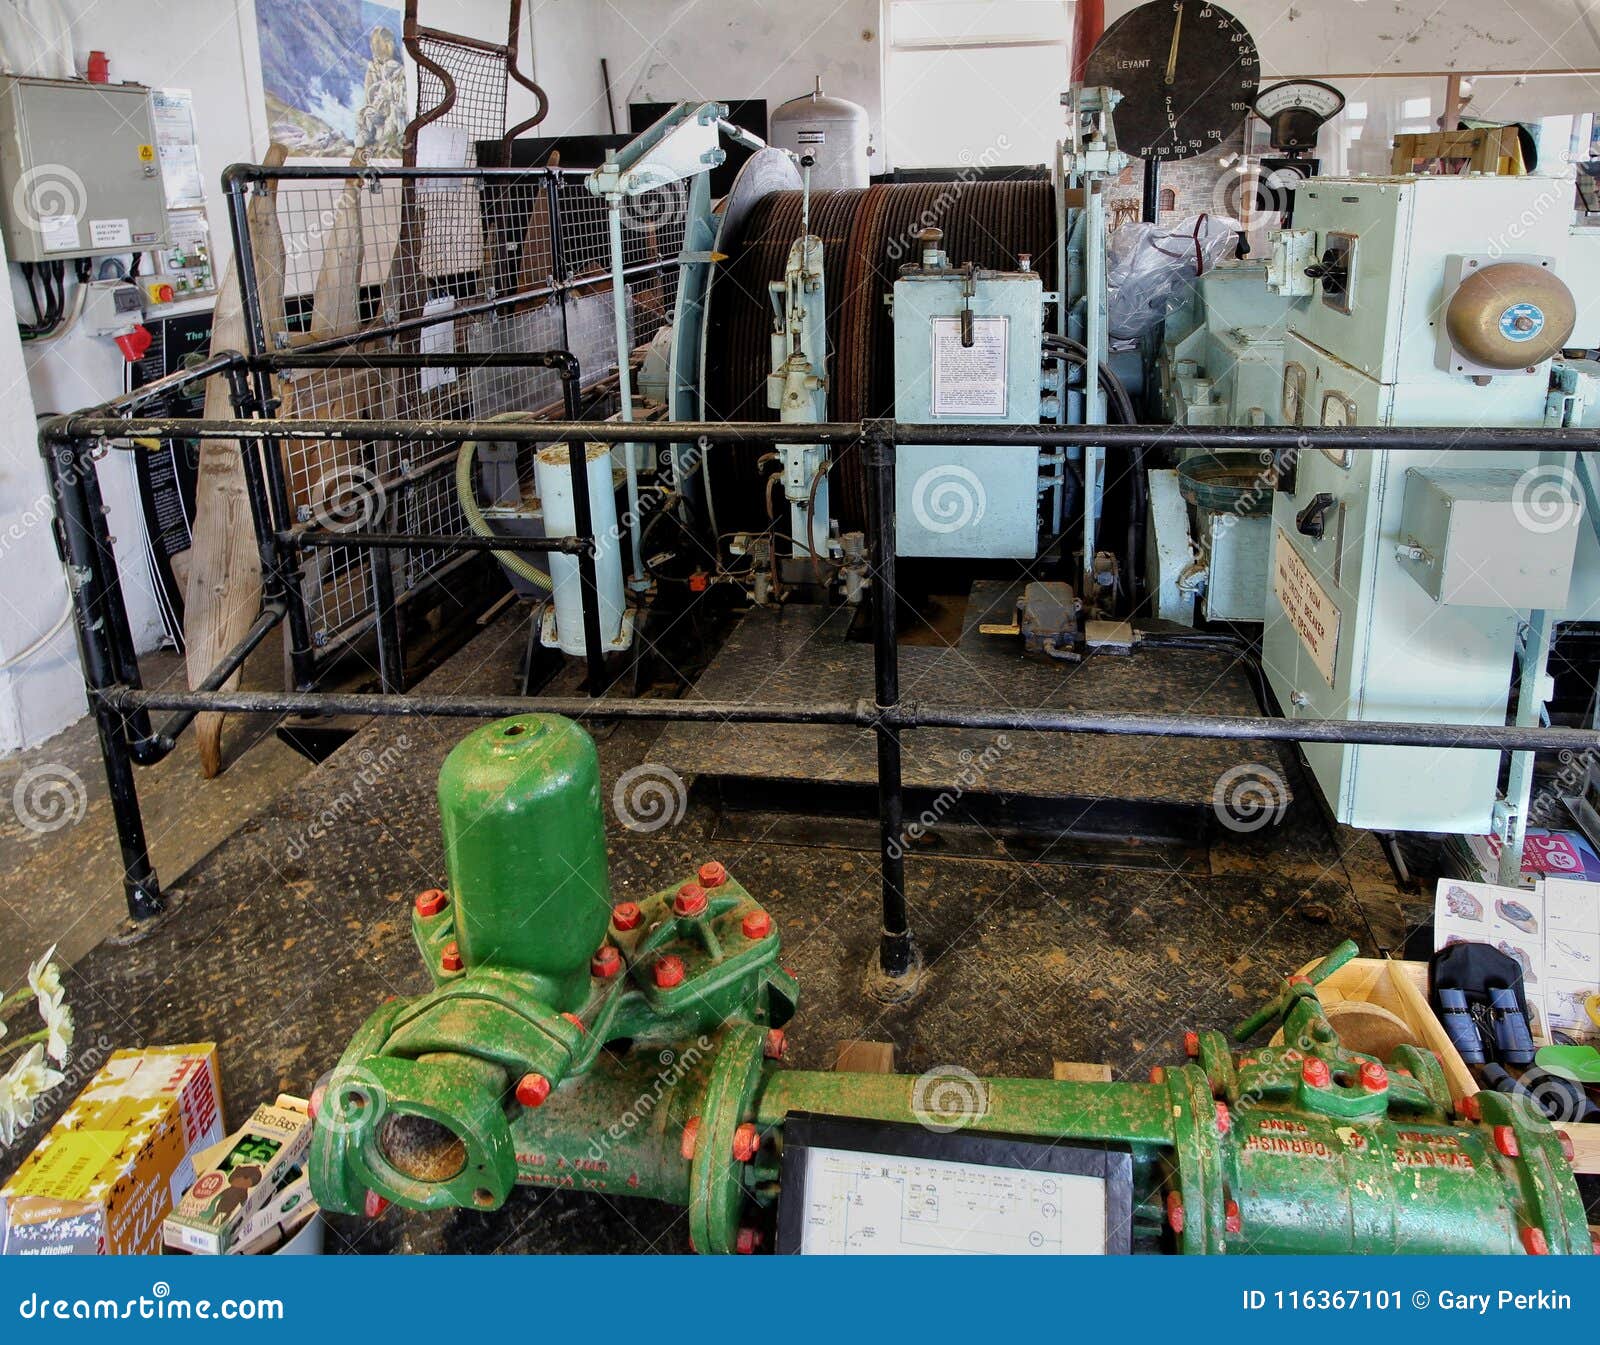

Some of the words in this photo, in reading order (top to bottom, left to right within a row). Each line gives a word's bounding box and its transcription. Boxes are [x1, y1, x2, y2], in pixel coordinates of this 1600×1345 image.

[1200, 9, 1212, 18] AD
[1231, 33, 1242, 42] 40
[1116, 59, 1151, 70] LEVANT
[1241, 58, 1252, 66] 60
[1231, 102, 1246, 111] 100
[1165, 96, 1178, 129] SLOW
[1207, 130, 1221, 139] 130
[1189, 140, 1203, 149] 150
[1141, 147, 1153, 155] BT
[1157, 147, 1170, 155] 180
[1174, 145, 1187, 154] 160
[1305, 582, 1321, 611] FROM
[1303, 602, 1325, 641] BREAKER
[1259, 1119, 1307, 1132] PUMP
